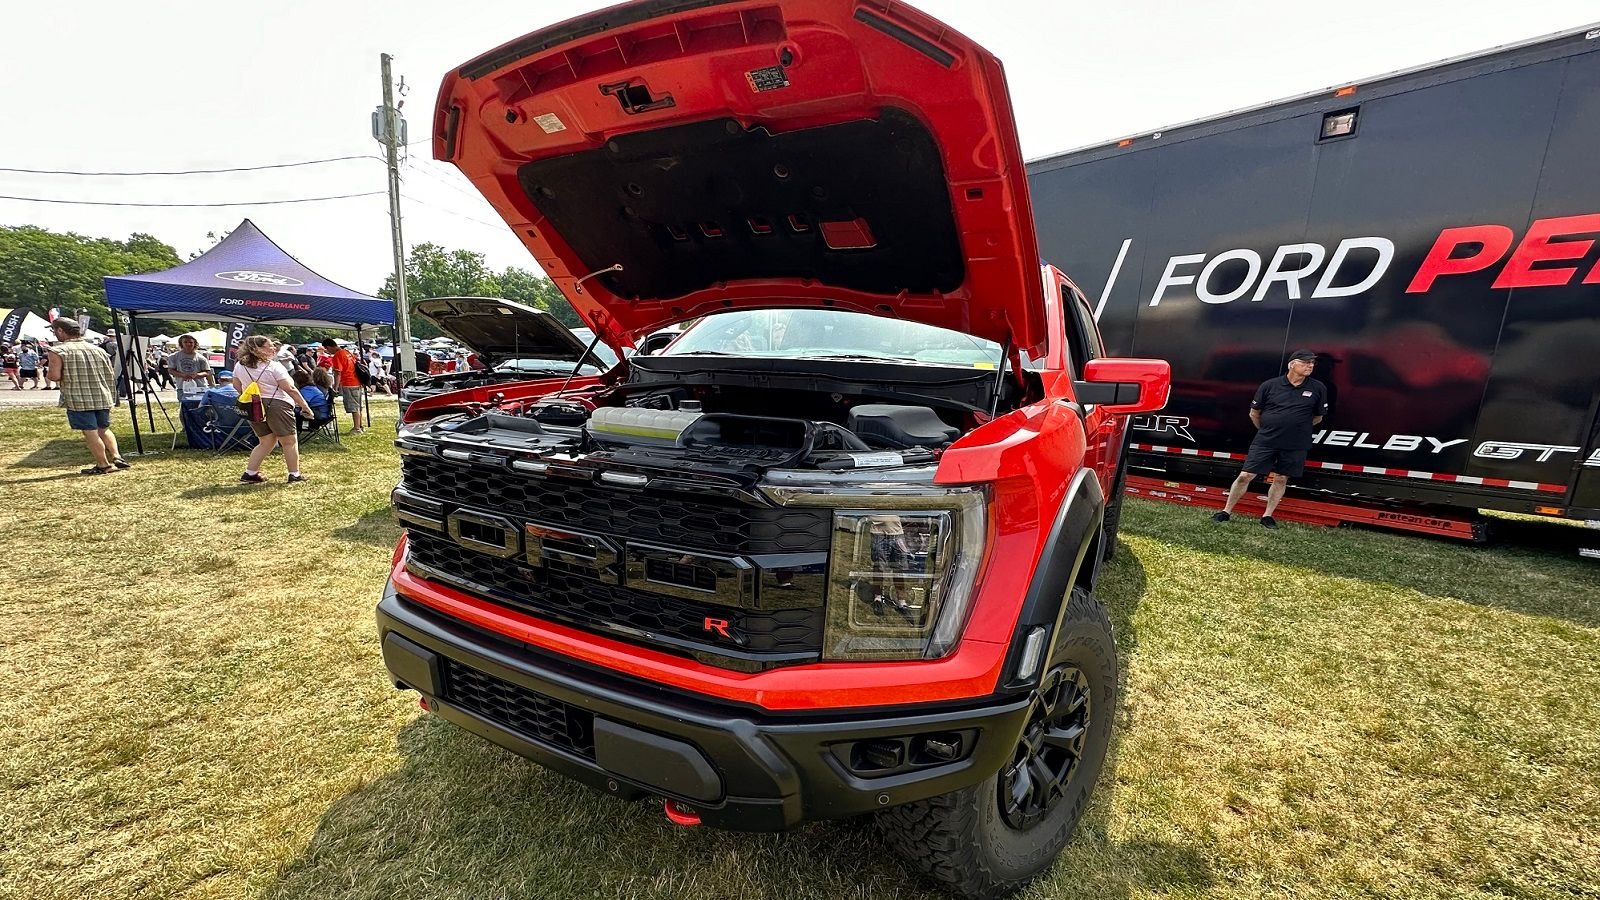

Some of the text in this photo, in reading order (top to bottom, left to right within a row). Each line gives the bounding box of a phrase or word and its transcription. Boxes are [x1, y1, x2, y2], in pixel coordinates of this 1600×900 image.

[1149, 213, 1600, 307] FORD PE
[230, 270, 290, 286] Ford
[245, 299, 310, 310] PERFORMANCE
[2, 314, 20, 342] ROUSH
[230, 322, 245, 346] ROU
[1311, 429, 1470, 454] HELBY
[1378, 512, 1422, 524] protean
[703, 616, 733, 640] R
